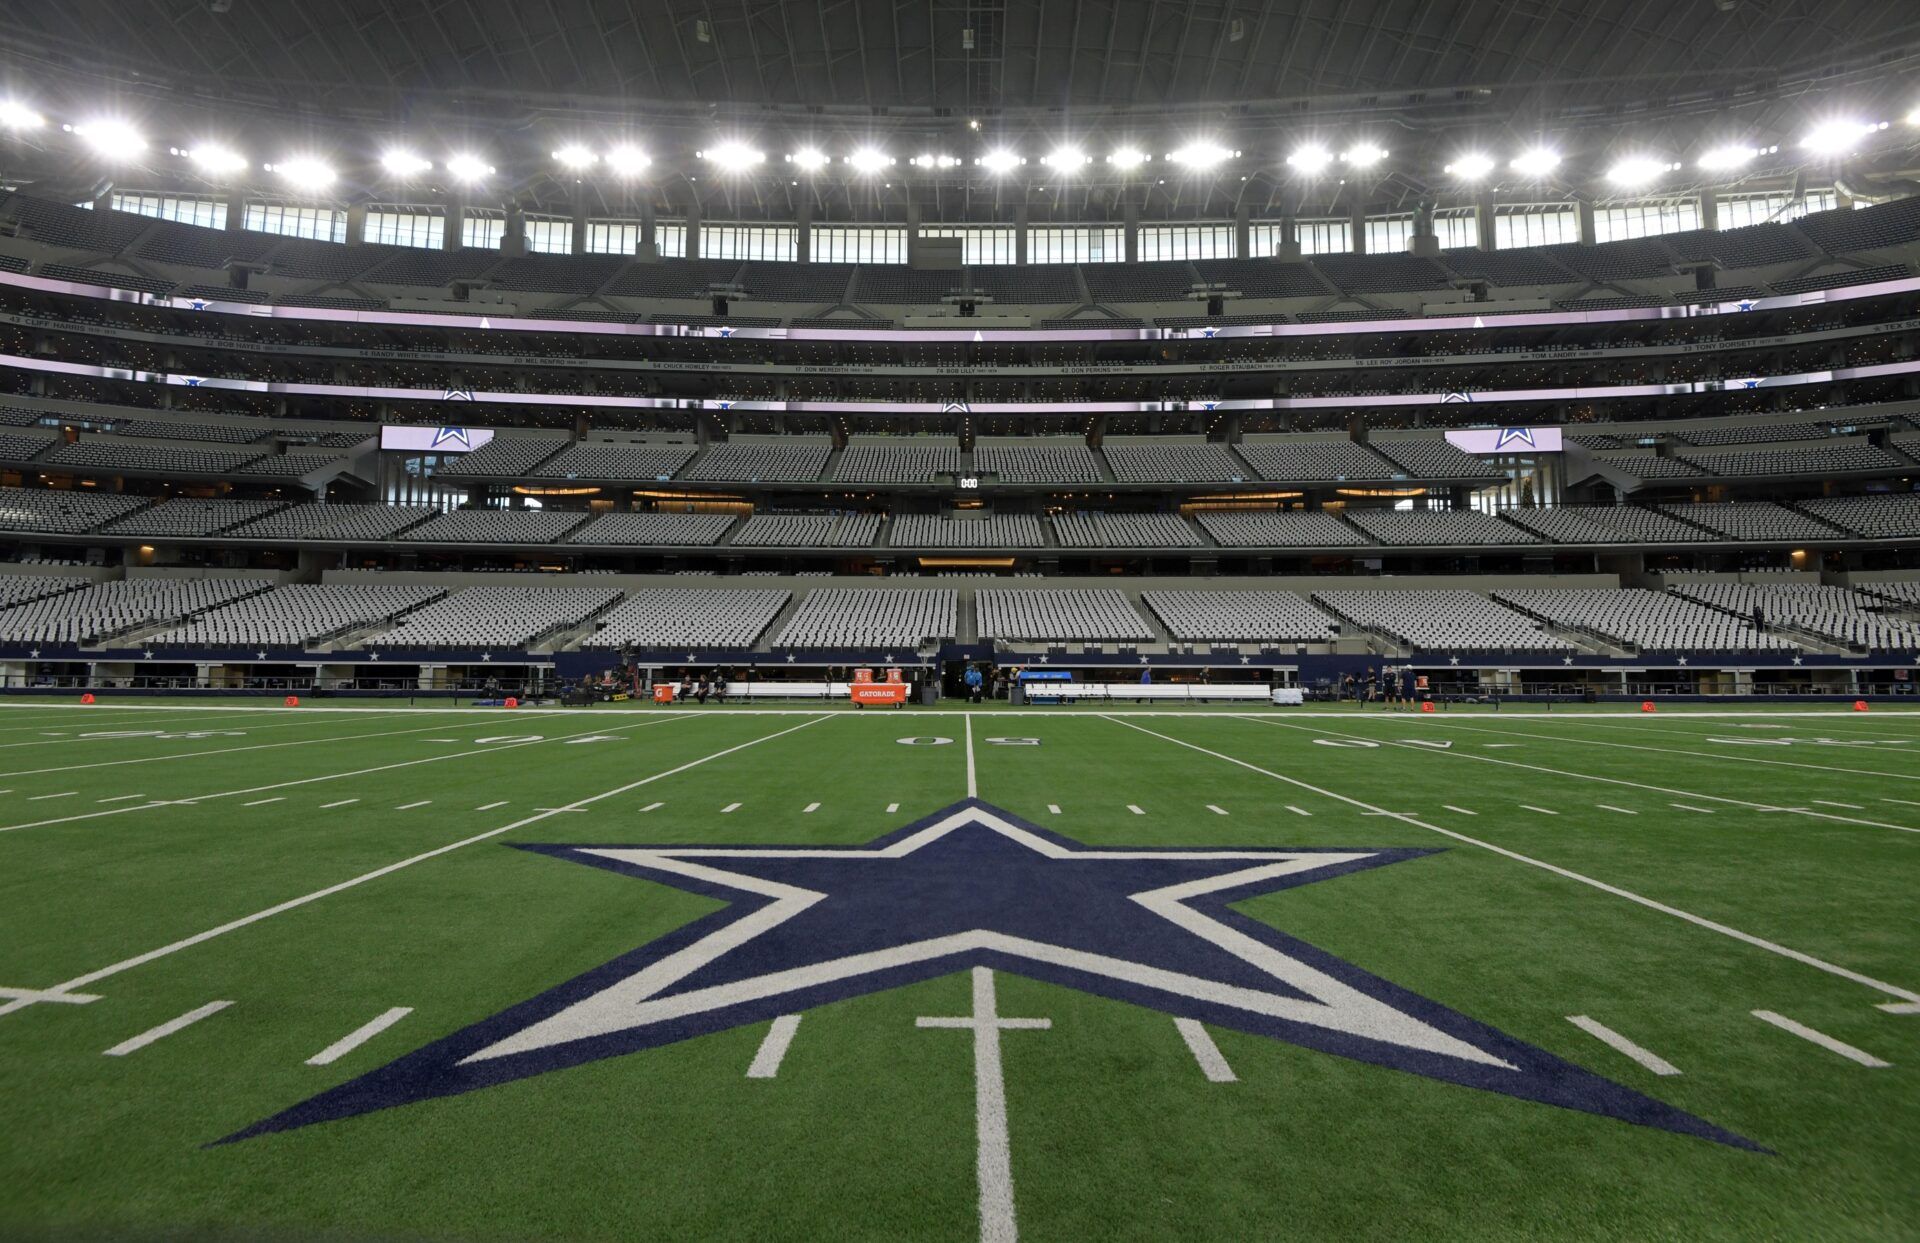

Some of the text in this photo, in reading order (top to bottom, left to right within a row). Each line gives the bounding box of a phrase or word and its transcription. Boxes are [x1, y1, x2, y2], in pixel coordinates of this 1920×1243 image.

[26, 319, 49, 327] CLIFF
[53, 322, 86, 332] HARRIS
[1719, 340, 1756, 348] DORSETT
[961, 479, 977, 488] 0:00
[656, 689, 662, 697] G
